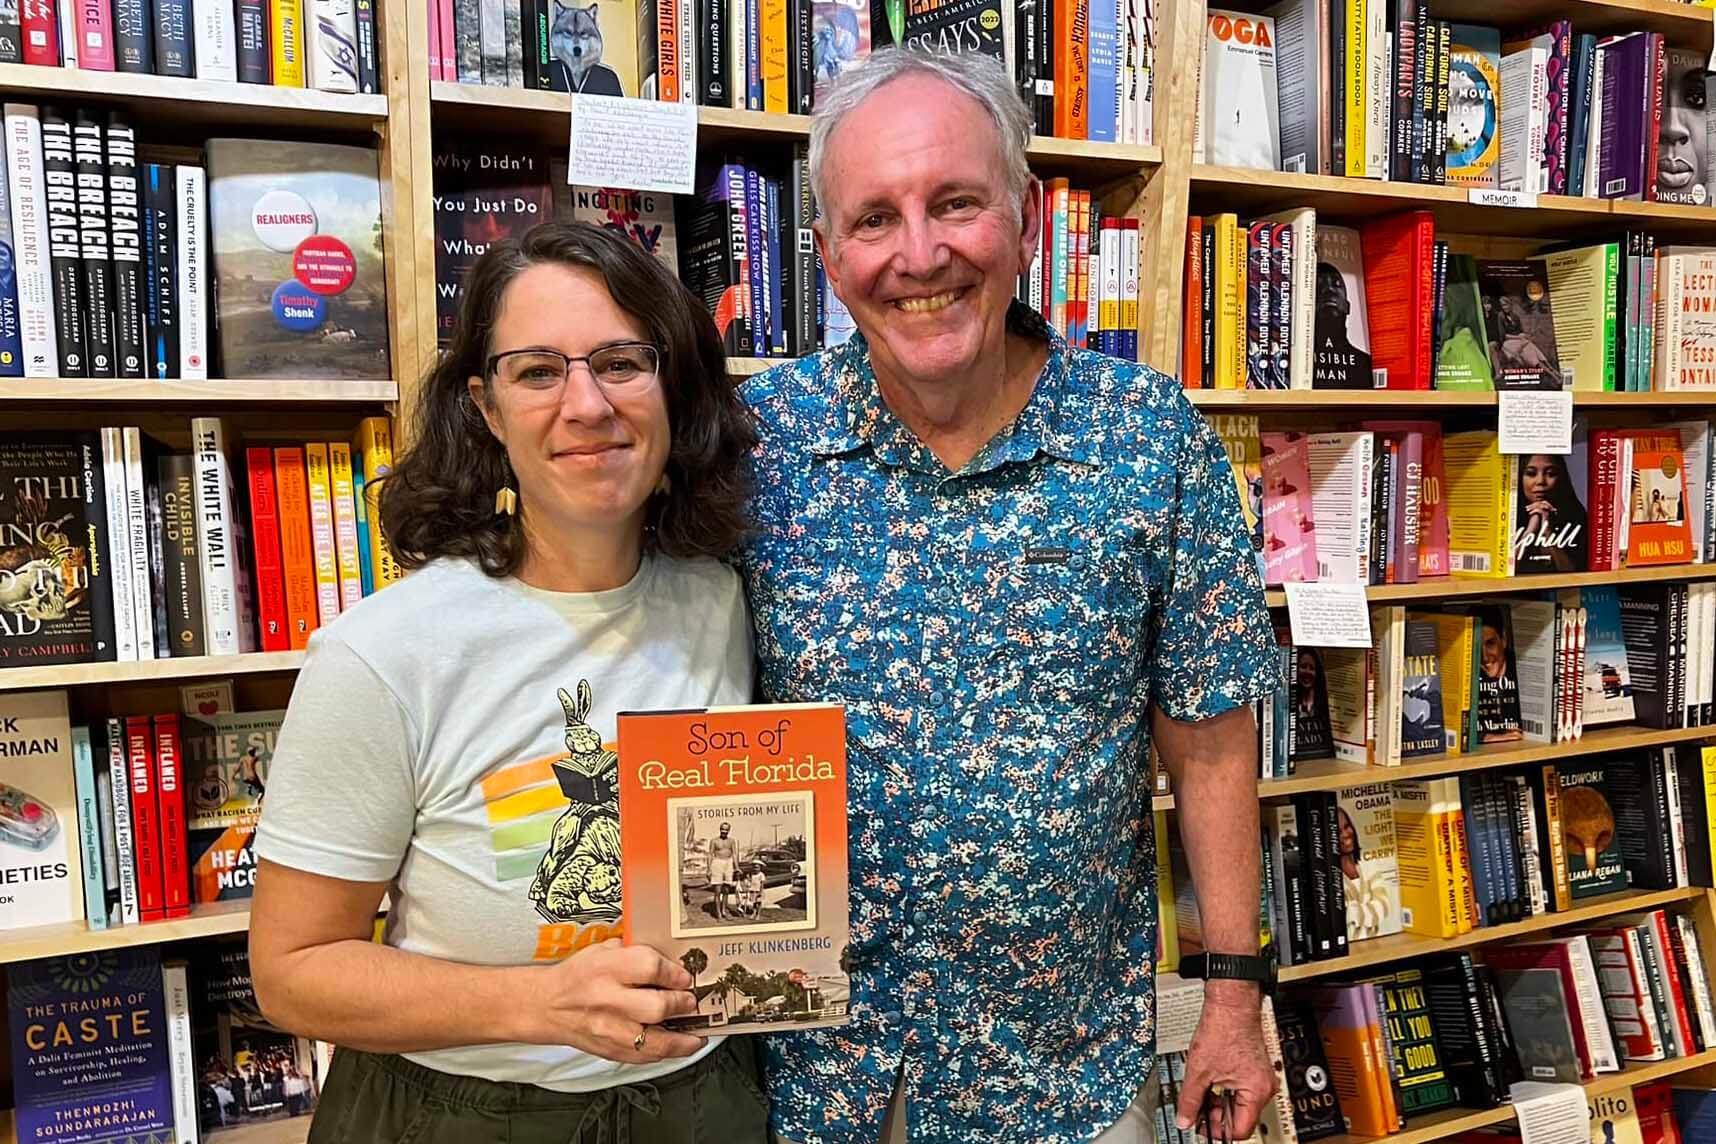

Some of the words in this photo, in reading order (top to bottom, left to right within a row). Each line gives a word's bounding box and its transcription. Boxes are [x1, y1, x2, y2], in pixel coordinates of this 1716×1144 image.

[129, 0, 144, 36] BETH
[171, 4, 185, 40] BETH
[242, 12, 255, 49] MATTEI
[659, 1, 674, 34] WHITE
[711, 23, 720, 75] QUESTIONS
[800, 9, 808, 71] SIXTY-EIGHT
[1424, 26, 1435, 82] CALIFORNIA
[661, 40, 676, 76] GIRLS
[1072, 45, 1084, 73] VICTORY
[1398, 21, 1415, 98] LADYPARTS
[1416, 42, 1425, 101] COPELAND
[1438, 28, 1450, 85] CALIFORNIA
[1072, 87, 1083, 117] ASSURED
[1423, 87, 1433, 111] SOUL
[1437, 89, 1448, 114] SOUL
[1459, 88, 1492, 100] MOVE
[14, 120, 31, 146] THE
[43, 122, 71, 162] THE
[74, 125, 102, 165] THE
[107, 128, 135, 167] THE
[17, 149, 32, 171] AGE
[434, 155, 471, 172] Why
[480, 155, 533, 170] Didn't
[19, 177, 33, 192] OF
[186, 178, 194, 195] THE
[728, 170, 745, 209] JOHN
[748, 170, 759, 200] GIRLS
[1482, 194, 1517, 205] MEMOIR
[46, 170, 79, 258] BREACH
[77, 173, 108, 260] BREACH
[187, 196, 196, 235] CRUELTY
[433, 197, 465, 212] You
[473, 198, 506, 214] Just
[514, 198, 537, 214] Do
[571, 190, 655, 213] INCITING
[750, 204, 760, 225] CAN
[22, 196, 38, 265] RESILIENCE
[110, 175, 140, 262] BREACH
[158, 211, 167, 254] ADAM
[256, 214, 313, 225] REALIGNERS
[188, 237, 196, 245] IS
[731, 214, 747, 260] GREEN
[751, 228, 760, 251] KISS
[1260, 230, 1269, 274] UNTAMED
[188, 247, 196, 264] THE
[752, 254, 761, 280] NOW
[1281, 231, 1290, 274] UNTAMED
[188, 266, 197, 294] POINT
[1058, 259, 1066, 292] ONLY
[1089, 258, 1097, 279] TONI
[160, 266, 170, 326] SCHIFF
[1259, 281, 1268, 323] GLENNON
[1280, 281, 1290, 323] GLENNON
[1607, 276, 1616, 320] HUSTLE
[2, 297, 15, 338] MARIA
[284, 307, 314, 319] Shenk
[1260, 326, 1268, 355] DOYLE
[1280, 326, 1289, 355] DOYLE
[1325, 337, 1333, 347] A
[1316, 367, 1347, 380] MAN
[199, 431, 216, 462] THE
[1597, 438, 1608, 456] Fly
[1406, 462, 1417, 480] CJ
[1598, 460, 1607, 485] Girl
[129, 489, 142, 520] WHITE
[202, 468, 222, 521] WHITE
[165, 492, 179, 541] CHILD
[177, 476, 194, 556] INVISIBLE
[1404, 485, 1417, 545] HAUSER
[315, 524, 330, 545] THE
[339, 519, 354, 543] THE
[132, 524, 145, 571] FRAGILITY
[207, 527, 225, 569] WALL
[340, 545, 357, 574] LAST
[1638, 541, 1661, 558] HUA
[1664, 540, 1684, 556] HSU
[317, 550, 333, 577] LAST
[381, 557, 389, 581] WAY
[1499, 676, 1515, 690] On
[1666, 660, 1675, 713] MANNING
[687, 722, 749, 756] Son
[758, 719, 791, 755] of
[131, 735, 148, 793] INFLAMED
[159, 734, 176, 792] INFLAMED
[638, 760, 714, 791] Real
[719, 754, 836, 787] Florida
[114, 769, 126, 807] HANDBOOK
[1340, 785, 1390, 799] MICHELLE
[1355, 796, 1391, 810] OBAMA
[117, 809, 127, 824] FOR
[697, 806, 736, 820] STORIES
[738, 805, 763, 817] FROM
[766, 804, 780, 815] MY
[782, 804, 801, 815] LIFE
[1373, 809, 1392, 821] THE
[1364, 820, 1393, 835] LIGHT
[1362, 847, 1394, 862] CARRY
[1481, 842, 1491, 878] MATTHEW
[122, 869, 134, 901] AMERICA
[1264, 852, 1273, 892] MURAKAMI
[1595, 864, 1621, 880] REGAN
[1449, 889, 1458, 926] MISFIT
[1462, 886, 1472, 922] MISFIT
[718, 942, 744, 957] JEFF
[749, 936, 832, 955] KLINKENBERG
[25, 1006, 55, 1020] THE
[60, 998, 122, 1016] TRAUMA
[128, 992, 146, 1005] OF
[1399, 987, 1426, 1011] THEY
[1469, 997, 1483, 1029] WILLIAM
[25, 1009, 152, 1051] CASTE
[1407, 1016, 1432, 1041] YOU
[27, 1055, 35, 1066] A
[38, 1052, 61, 1065] Dalit
[63, 1048, 102, 1061] Feminist
[104, 1041, 153, 1054] Meditation
[1404, 1044, 1437, 1070] GOOD
[1475, 1030, 1491, 1063] SHATNER
[48, 1061, 108, 1076] Survivorship,
[110, 1056, 147, 1069] Healing,
[63, 1076, 77, 1086] and
[81, 1070, 122, 1083] Abolition
[35, 1109, 156, 1136] SOUNDARARAJAN
